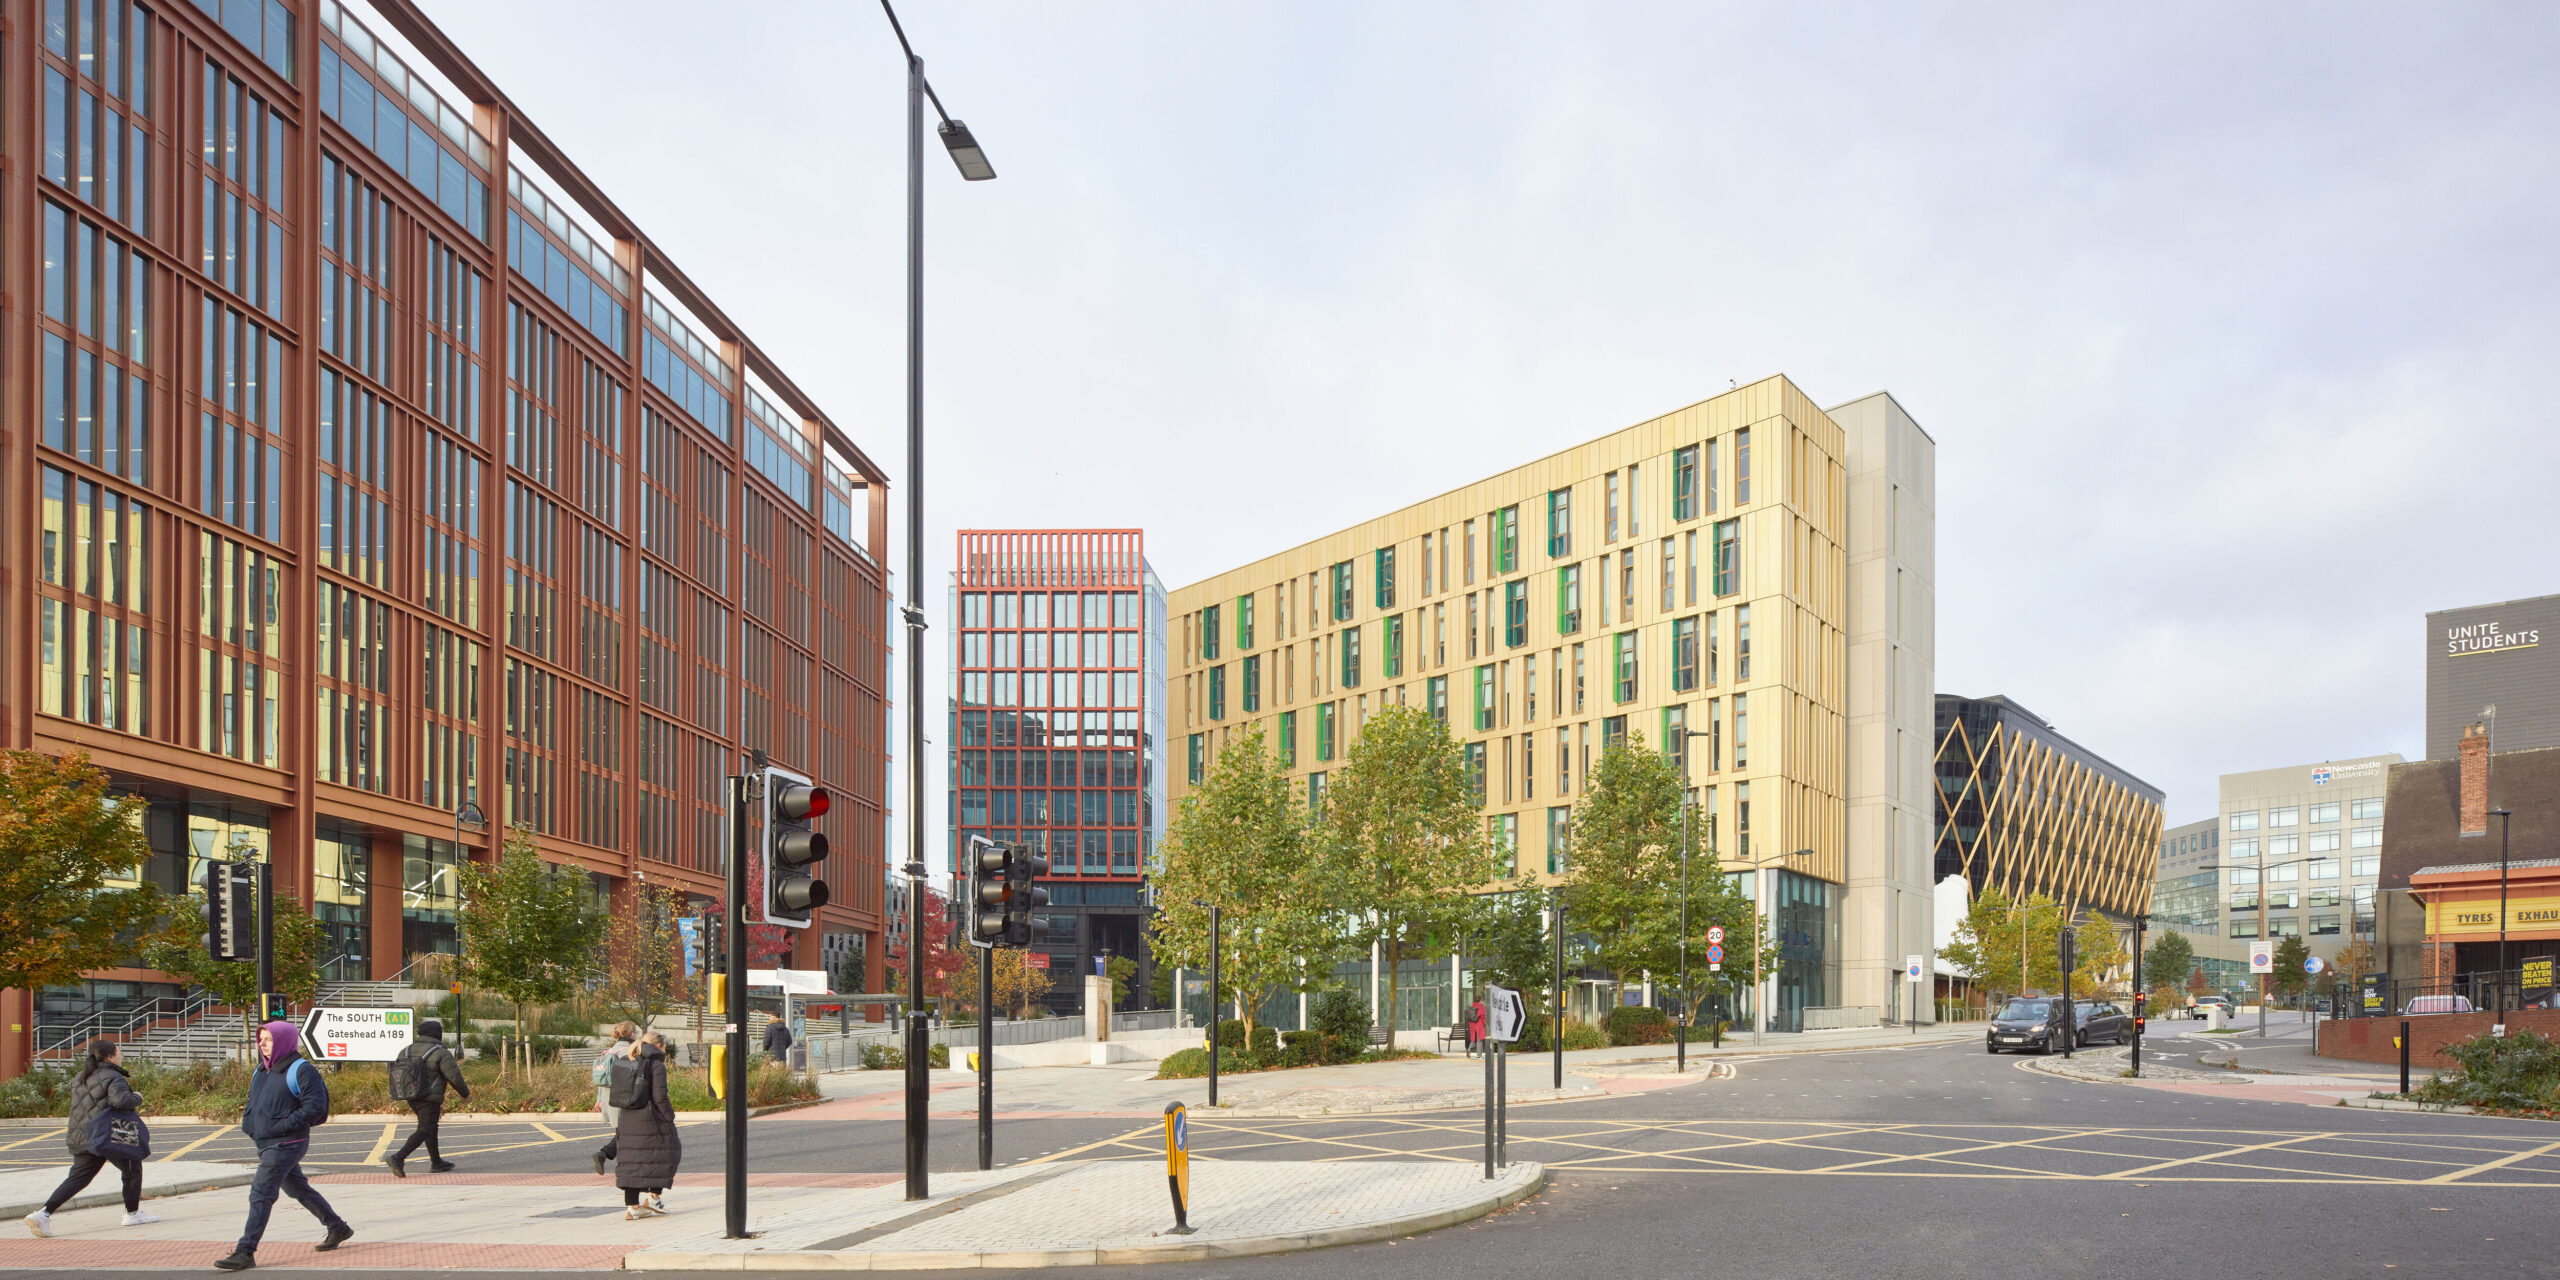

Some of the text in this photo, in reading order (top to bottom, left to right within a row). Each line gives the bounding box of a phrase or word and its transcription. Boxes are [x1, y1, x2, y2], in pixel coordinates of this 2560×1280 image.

[2448, 622, 2499, 640] UNITE
[2448, 630, 2539, 653] STUDENTS
[2331, 761, 2381, 773] Newcastle
[2331, 769, 2380, 780] University
[2457, 910, 2560, 923] TYRES EXHAU
[1709, 931, 1722, 940] 20
[2523, 961, 2552, 971] NEVER
[2522, 970, 2552, 978] BEATEN
[327, 1013, 409, 1024] The SOUTH (A1)
[327, 1029, 405, 1039] Gateshead A189
